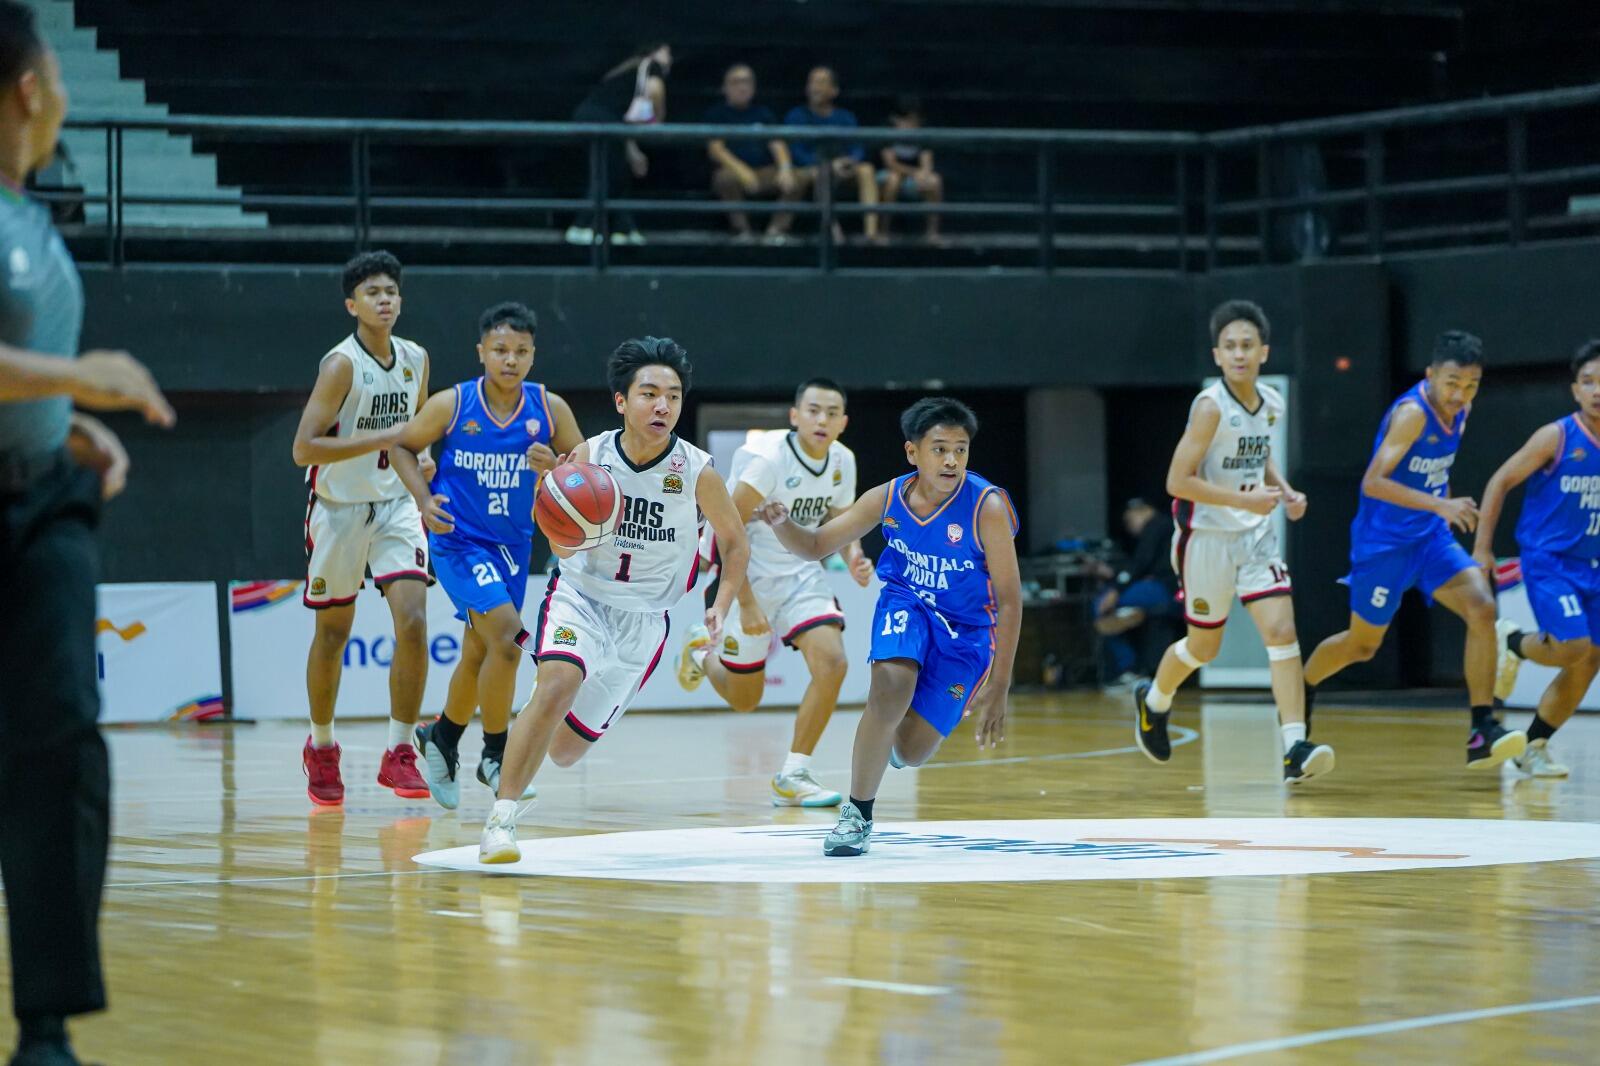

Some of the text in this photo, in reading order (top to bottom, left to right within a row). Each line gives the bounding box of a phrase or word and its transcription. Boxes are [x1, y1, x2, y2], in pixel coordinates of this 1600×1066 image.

[371, 392, 408, 416] ARAS
[454, 449, 530, 471] GORONTA
[477, 470, 520, 488] MUDA
[488, 492, 509, 516] 21
[623, 494, 664, 528] RAS
[614, 523, 675, 542] NGMUDA
[472, 561, 502, 587] 21
[615, 553, 631, 582] 1
[902, 562, 949, 590] MUDA
[1370, 586, 1390, 608] 5
[1558, 594, 1583, 617] 11
[881, 609, 909, 636] 13
